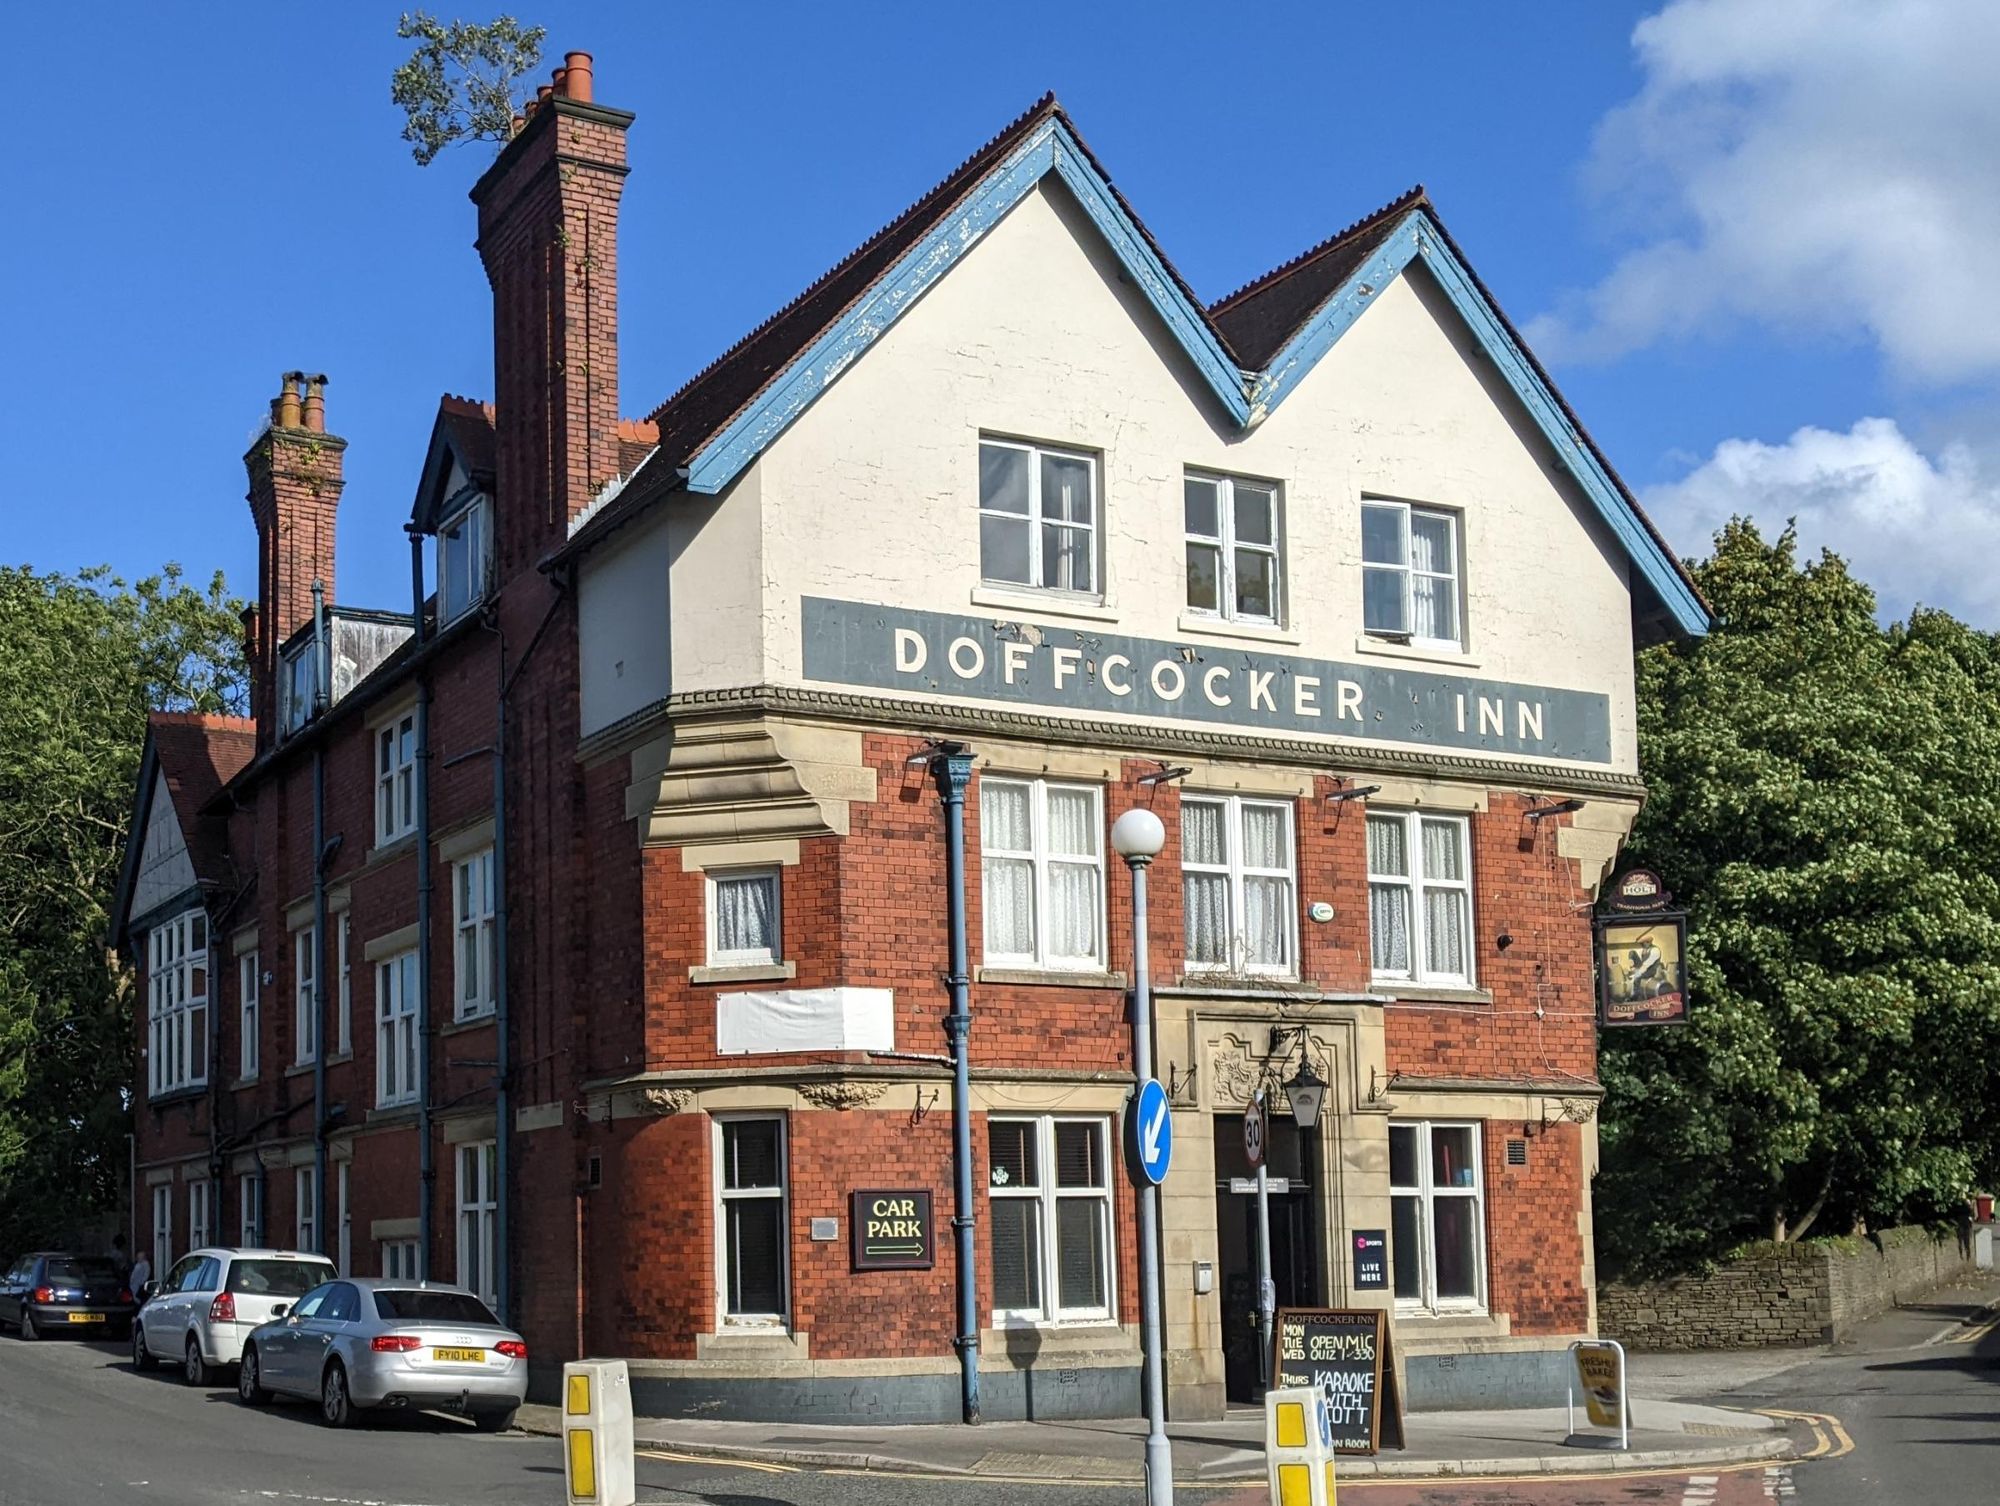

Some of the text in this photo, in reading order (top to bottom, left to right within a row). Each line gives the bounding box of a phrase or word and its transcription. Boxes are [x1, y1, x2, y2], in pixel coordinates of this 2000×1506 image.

[894, 627, 1544, 741] DOFFCOCKER INN
[1625, 886, 1653, 894] HOLT
[1613, 995, 1673, 1012] DOFFCOCKER
[1246, 1119, 1260, 1149] 30
[873, 1200, 915, 1217] CAR
[867, 1221, 922, 1238] PARK
[1361, 1263, 1380, 1271] LIVE
[1361, 1273, 1381, 1281] HERE
[1287, 1315, 1375, 1324] DOFFCOCKER INN
[1283, 1324, 1304, 1336] MON
[1282, 1337, 1303, 1348] TUE
[1310, 1335, 1343, 1350] OPEN
[438, 1350, 480, 1361] FY10 LHE
[1282, 1349, 1305, 1360] WED
[1310, 1349, 1336, 1360] QUIZ
[1280, 1369, 1375, 1393] THURS KARAOKE
[1345, 1438, 1370, 1449] ROOM
